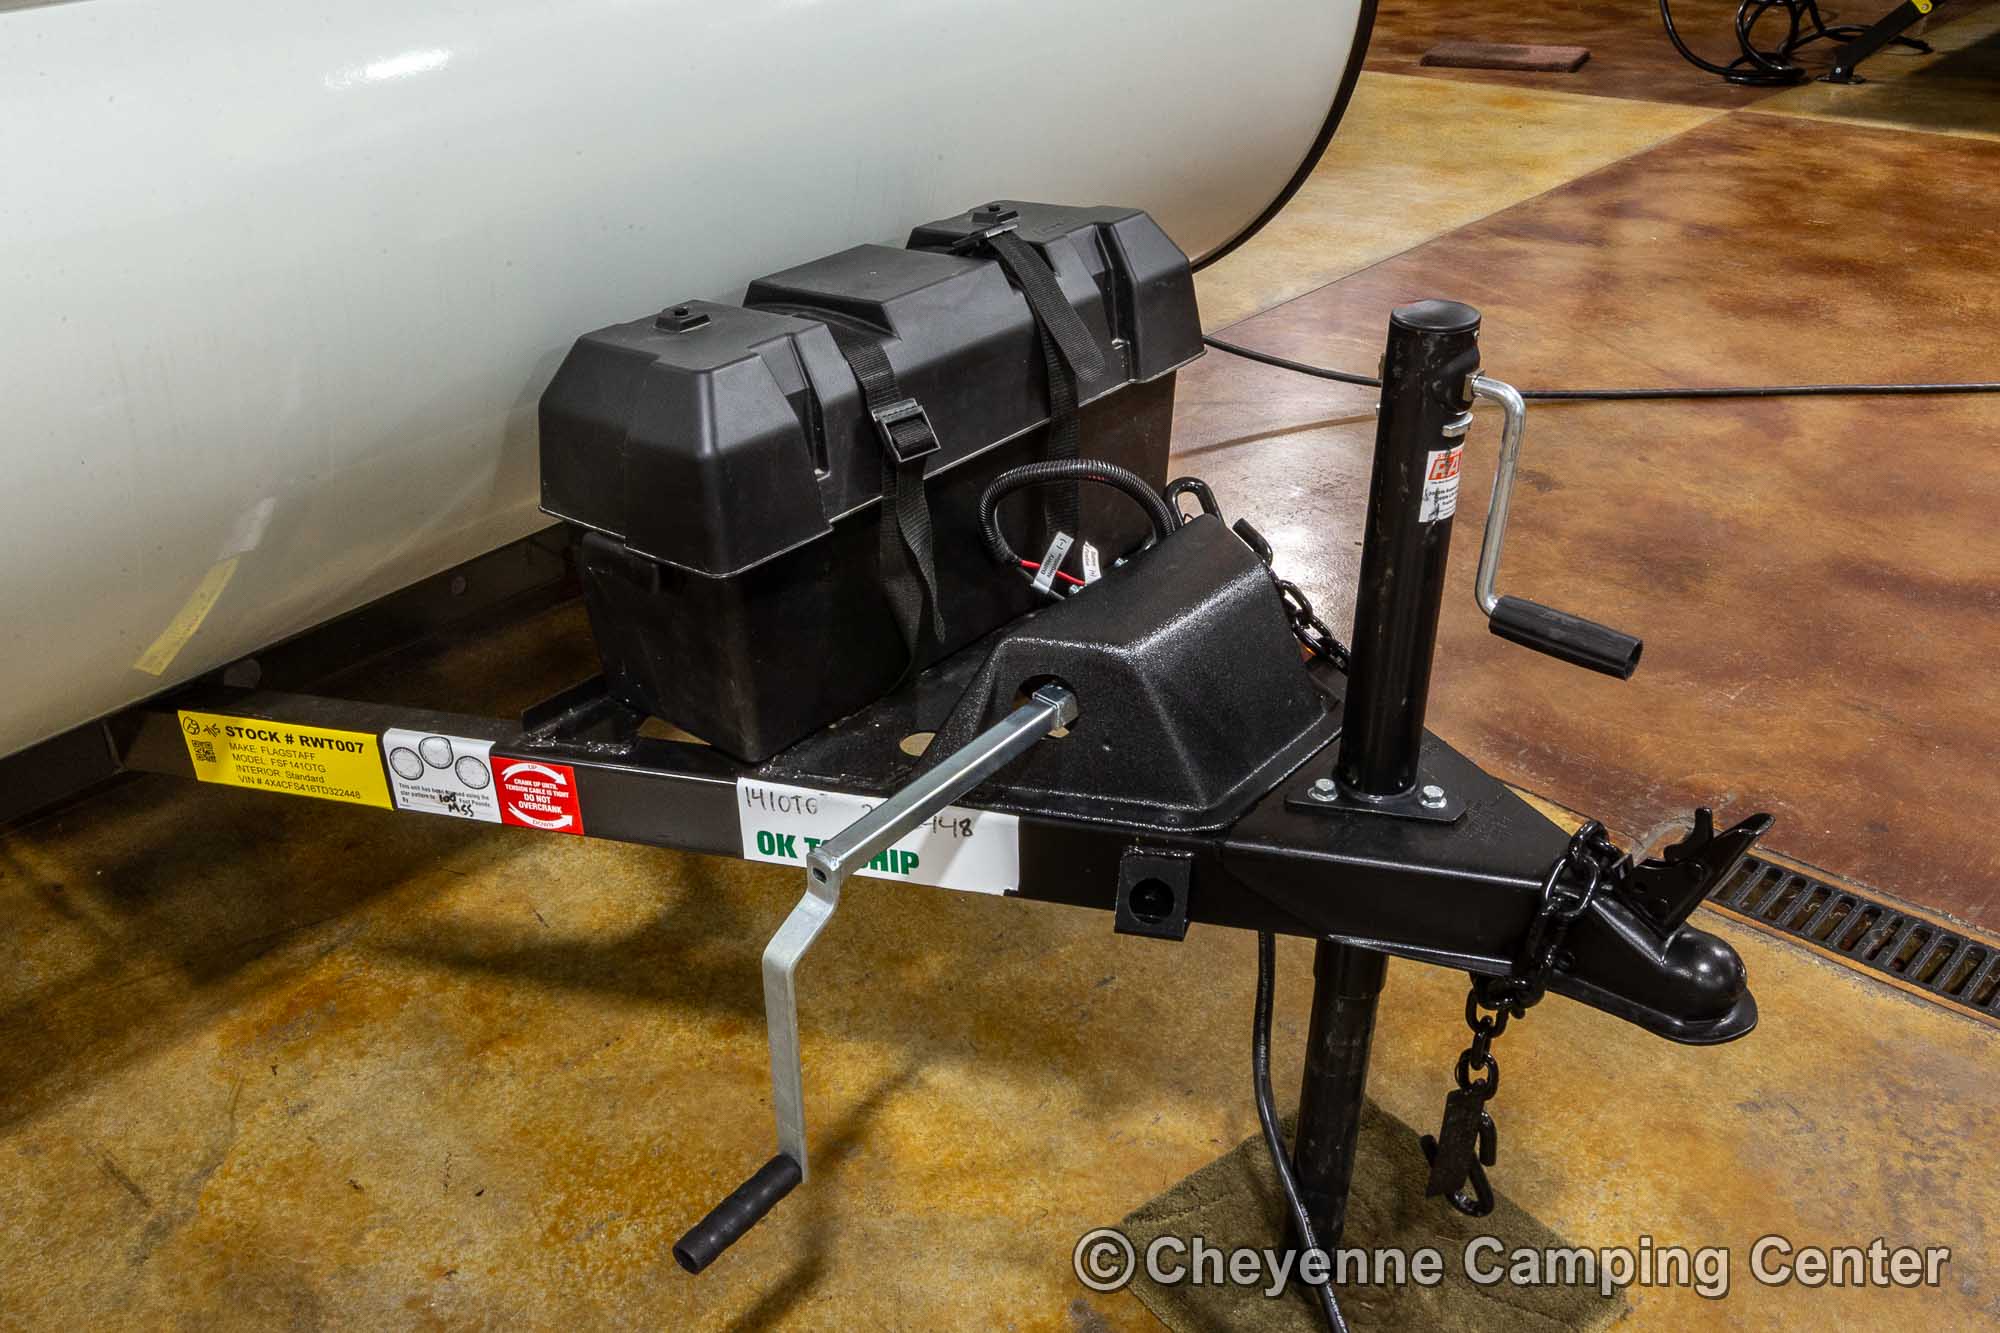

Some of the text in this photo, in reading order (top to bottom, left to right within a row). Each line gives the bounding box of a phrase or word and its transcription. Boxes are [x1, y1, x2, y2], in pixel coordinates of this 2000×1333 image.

[225, 726, 364, 753] STOCK # RWT007
[261, 746, 315, 760] FLAGSTAFF
[238, 775, 255, 784] VIN
[285, 770, 325, 783] Standard
[513, 778, 532, 787] CRANK
[505, 783, 528, 792] TENSION
[529, 787, 545, 795] CABLE
[523, 793, 551, 804] DO NOT
[518, 800, 562, 814] OVERCRANK
[757, 830, 798, 858] OK
[862, 848, 919, 875] HIP
